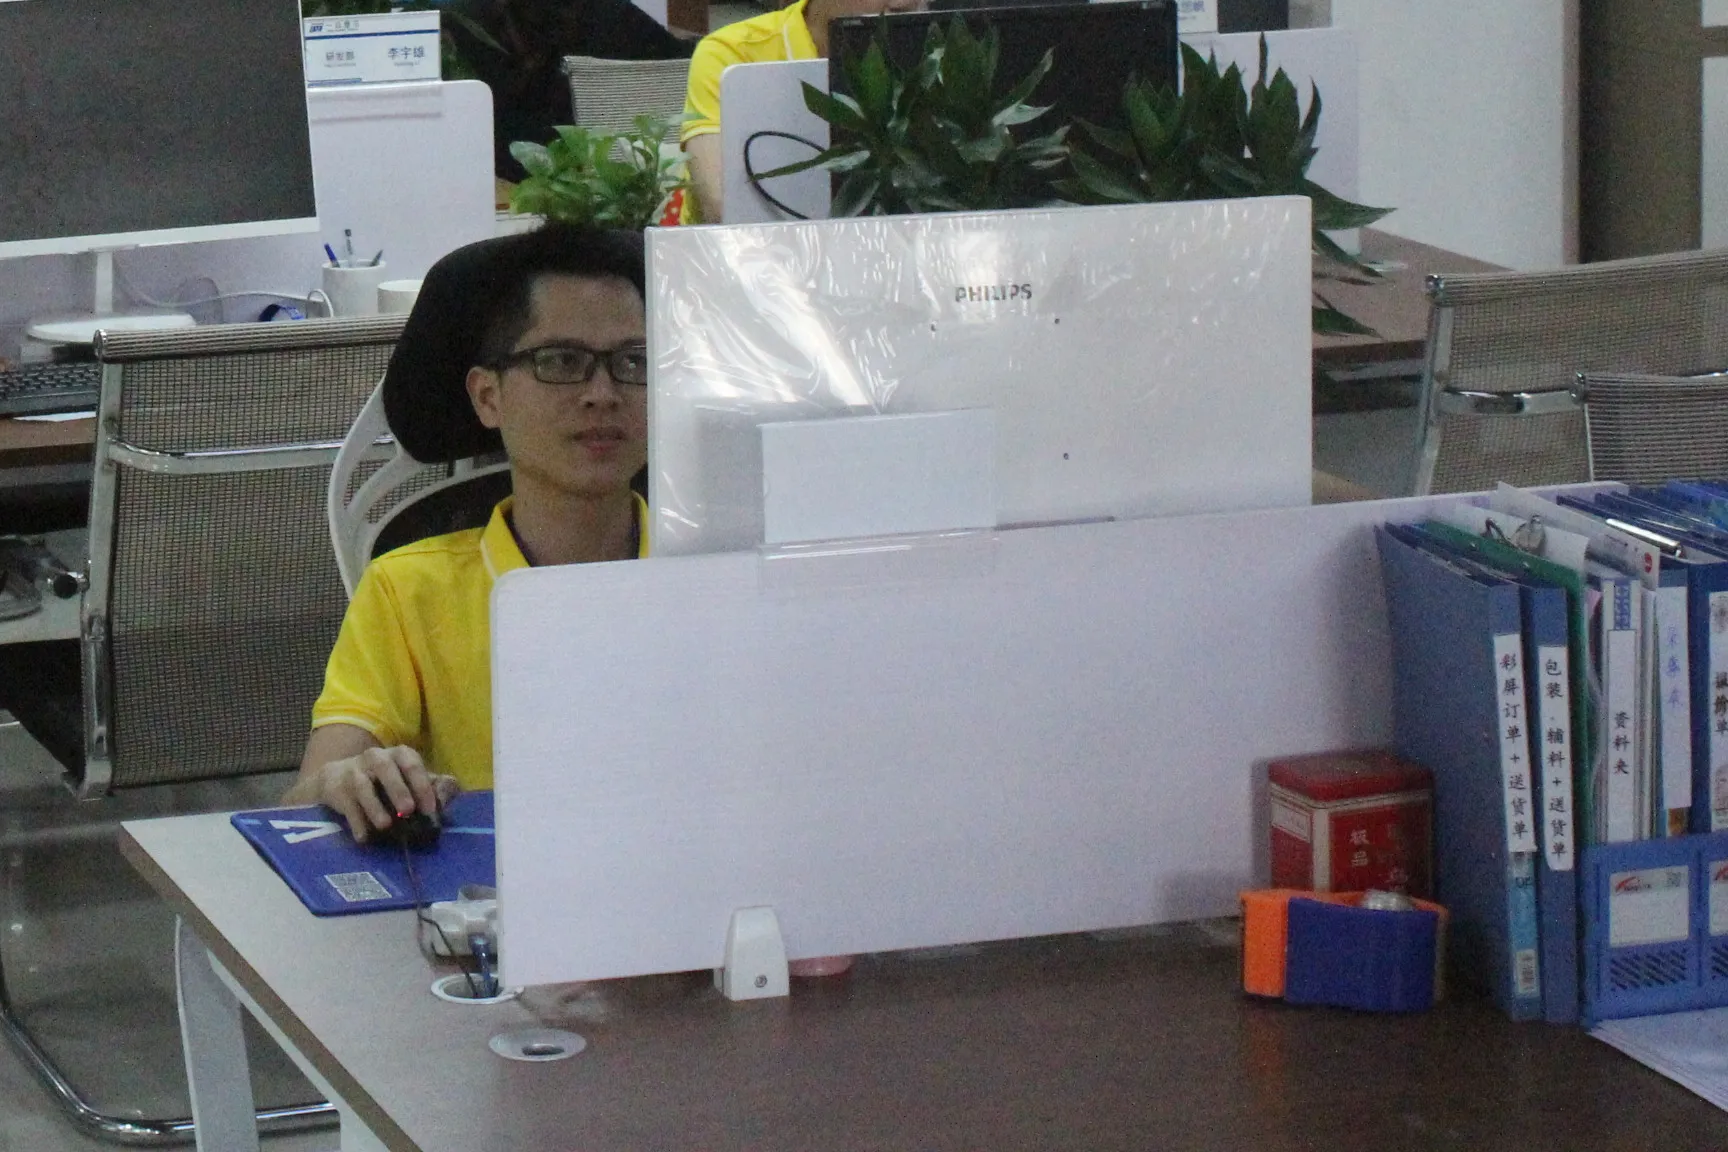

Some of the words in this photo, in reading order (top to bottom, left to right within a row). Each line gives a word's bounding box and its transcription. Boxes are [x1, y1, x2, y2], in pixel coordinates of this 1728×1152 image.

[955, 282, 1033, 304] PHILIPS
[1612, 710, 1630, 776] 资料夹
